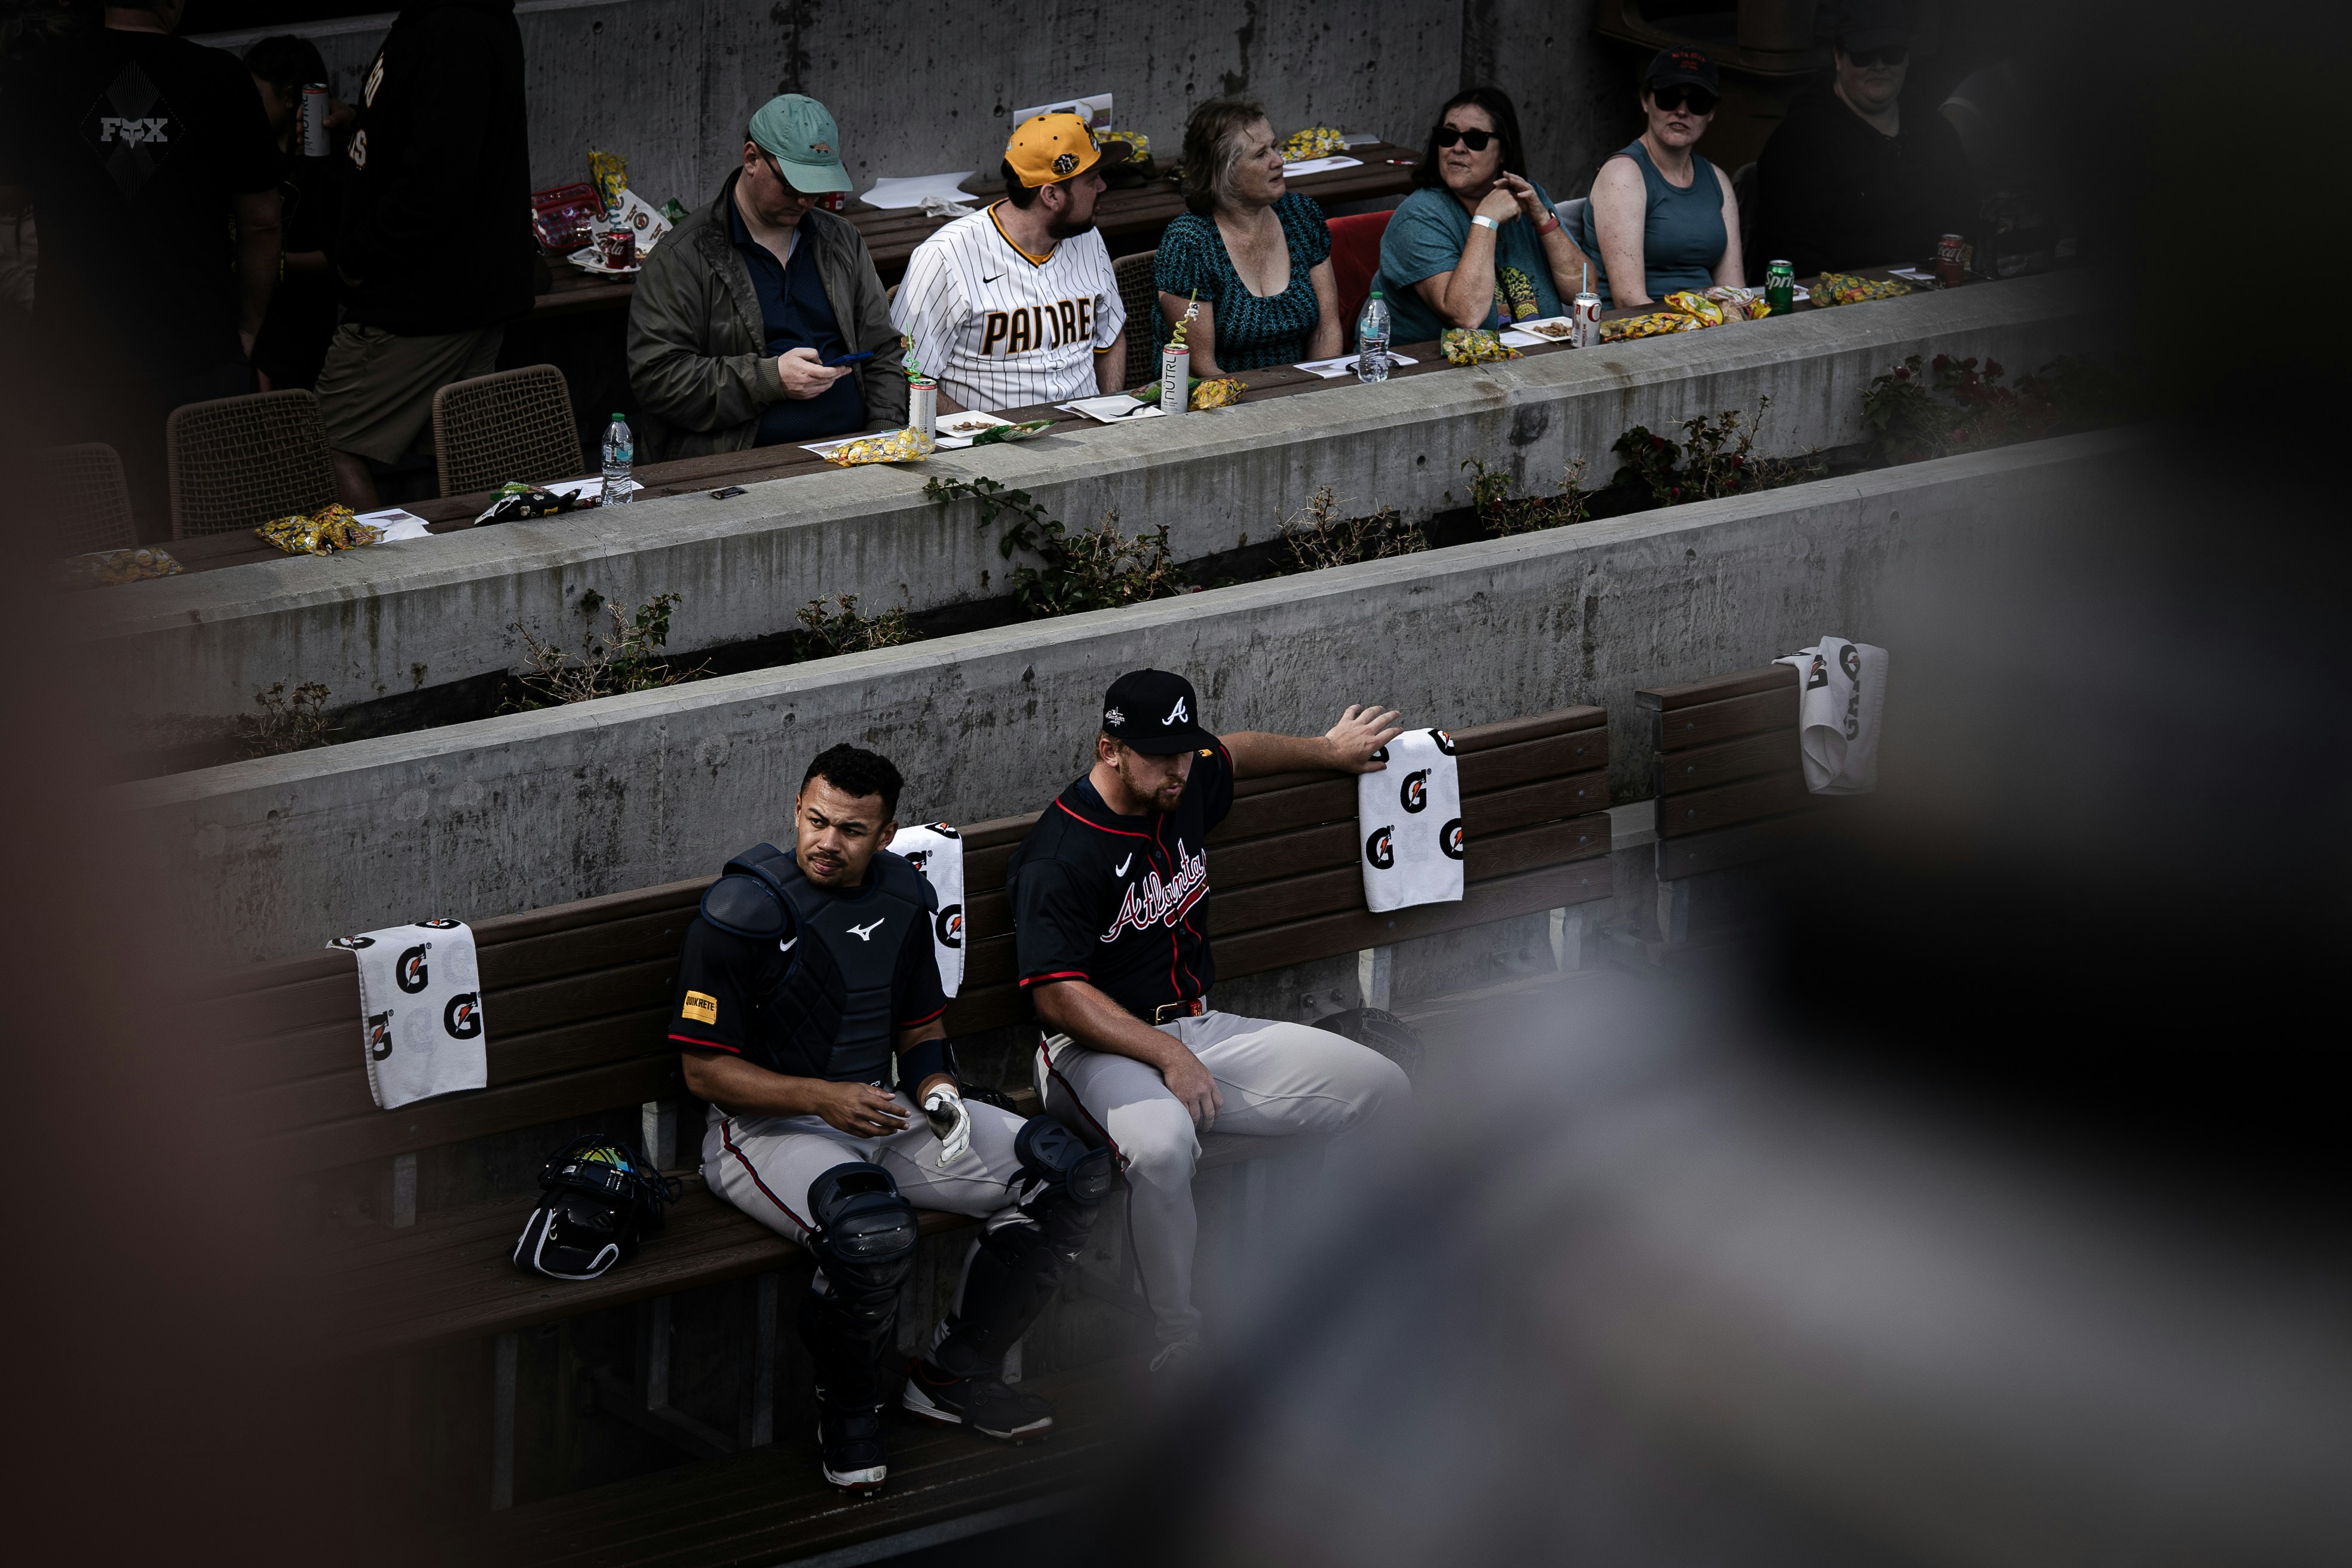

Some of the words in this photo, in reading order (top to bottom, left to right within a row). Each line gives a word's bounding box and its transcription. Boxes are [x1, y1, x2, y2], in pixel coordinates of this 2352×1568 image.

[1162, 696, 1189, 725] A
[1400, 769, 1427, 814] G
[1366, 825, 1395, 870] G
[1100, 838, 1207, 943] Atlanta
[396, 943, 428, 994] G
[443, 991, 482, 1040] G
[685, 996, 715, 1011] QUIKRETE
